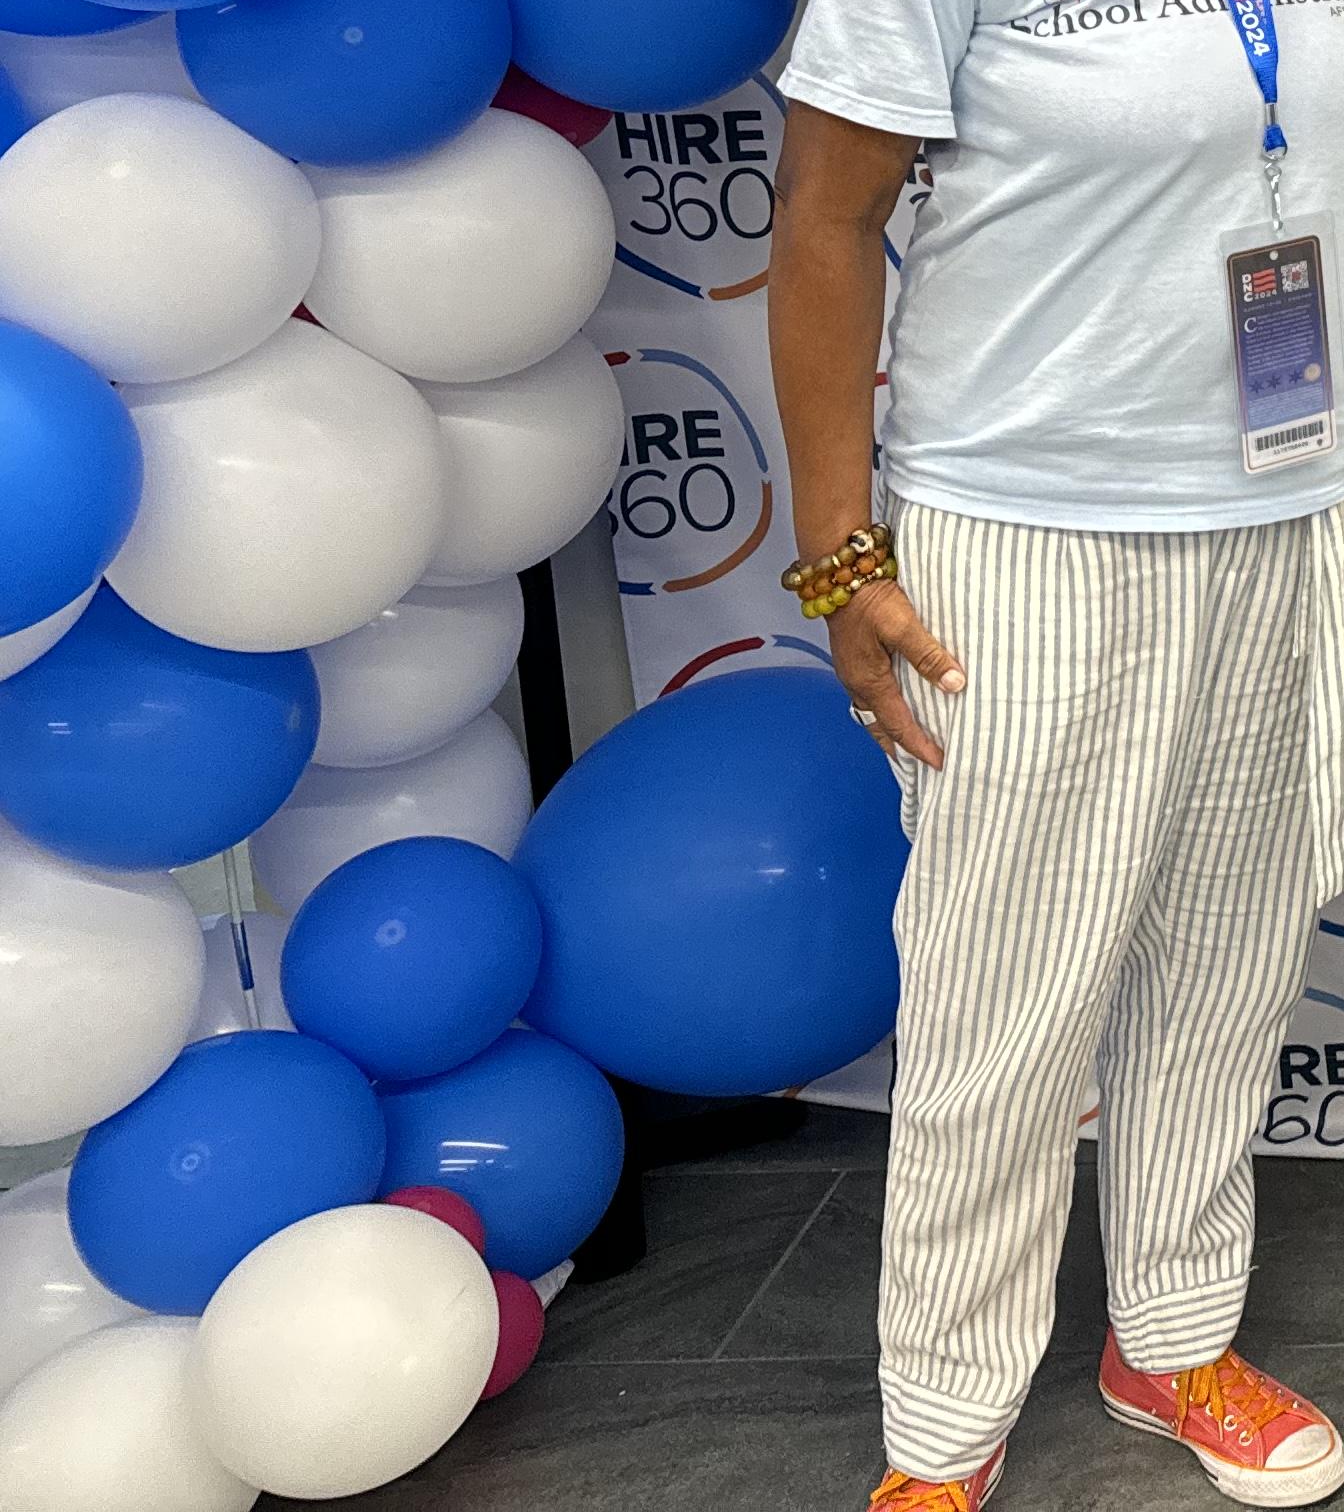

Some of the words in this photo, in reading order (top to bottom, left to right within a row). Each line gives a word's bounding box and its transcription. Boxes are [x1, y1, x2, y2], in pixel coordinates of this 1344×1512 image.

[1236, 0, 1271, 57] 2024
[614, 110, 768, 165] HIRE
[623, 166, 774, 241] 360
[621, 410, 726, 466] RE
[612, 462, 736, 540] 60
